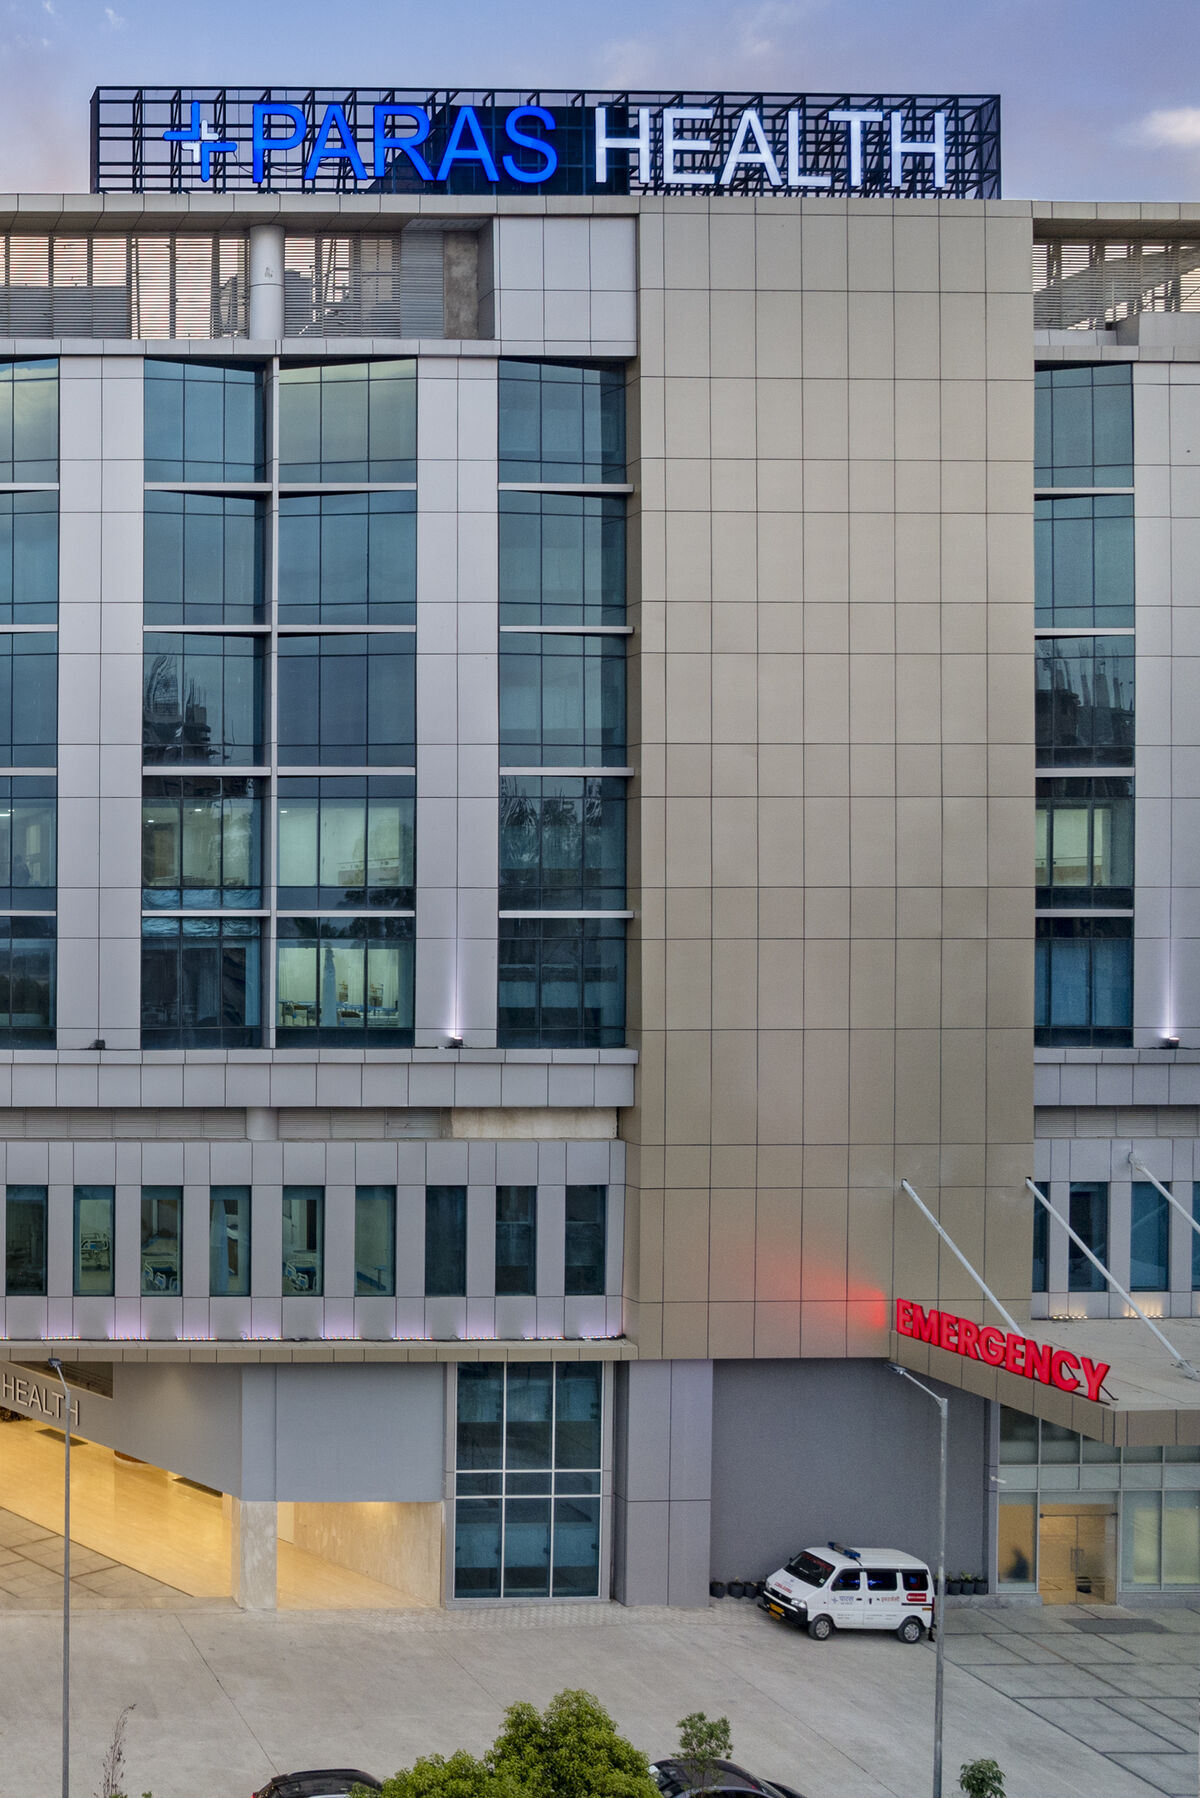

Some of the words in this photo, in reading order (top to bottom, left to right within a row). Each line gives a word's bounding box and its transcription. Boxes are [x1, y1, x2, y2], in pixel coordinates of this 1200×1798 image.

[252, 104, 557, 184] PARAS
[595, 107, 947, 188] HEALTH
[896, 1298, 1110, 1401] EMERGENCY
